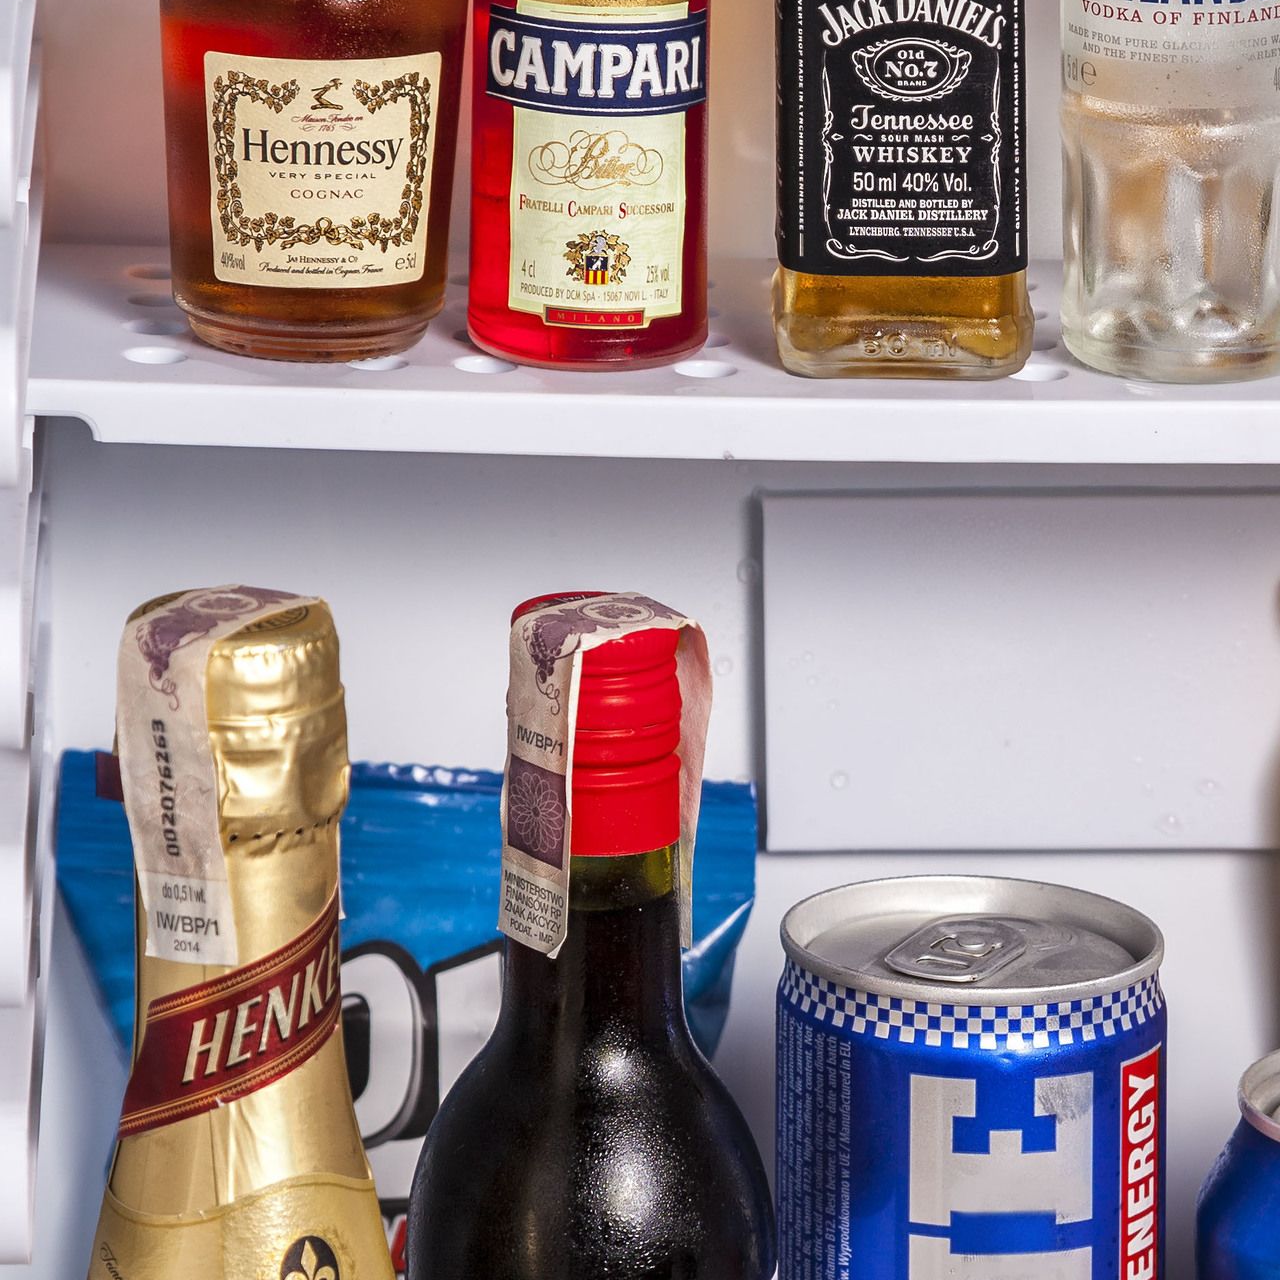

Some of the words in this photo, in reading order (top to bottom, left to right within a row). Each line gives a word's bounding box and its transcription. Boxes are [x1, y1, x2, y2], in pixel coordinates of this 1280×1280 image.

[1153, 10, 1182, 25] OF
[1068, 22, 1090, 38] MADE
[1091, 30, 1121, 46] FROM
[1125, 37, 1158, 50] PURE
[491, 27, 703, 99] CAMPARI
[897, 49, 925, 60] Old
[1082, 41, 1101, 54] AND
[1103, 46, 1127, 59] THE
[1130, 51, 1178, 64] FINEST
[851, 104, 974, 131] Tennessee
[242, 127, 405, 171] Hennessy
[880, 134, 911, 143] SOUR
[914, 134, 945, 143] MASH
[852, 145, 973, 164] WHISKEY
[268, 171, 306, 180] VERY
[314, 172, 377, 180] SPECIAL
[853, 172, 876, 192] 50
[878, 172, 897, 192] ml
[901, 171, 939, 193] 40%
[943, 171, 973, 192] Vol.
[290, 189, 364, 200] COGNAC
[852, 198, 896, 208] DISTILLED
[899, 198, 917, 208] AND
[920, 198, 959, 208] BOTTLED
[961, 199, 974, 208] BY
[519, 194, 564, 214] FRATELLI
[568, 200, 613, 218] CAMPARI
[619, 201, 676, 220] SUCCESSORI
[837, 209, 868, 220] JACK
[870, 209, 915, 220] DANIEL
[918, 209, 988, 221] DISTILLERY
[516, 723, 565, 759] IW/BP/1
[504, 870, 564, 909] MINISTERSTWO
[505, 885, 549, 916] FINANSÓW
[549, 906, 562, 920] RP
[156, 909, 220, 937] IW/BP/1
[504, 898, 527, 921] ZNAK
[527, 909, 562, 936] AKCYZY
[173, 938, 200, 953] 2014
[181, 925, 341, 1084] HENKE
